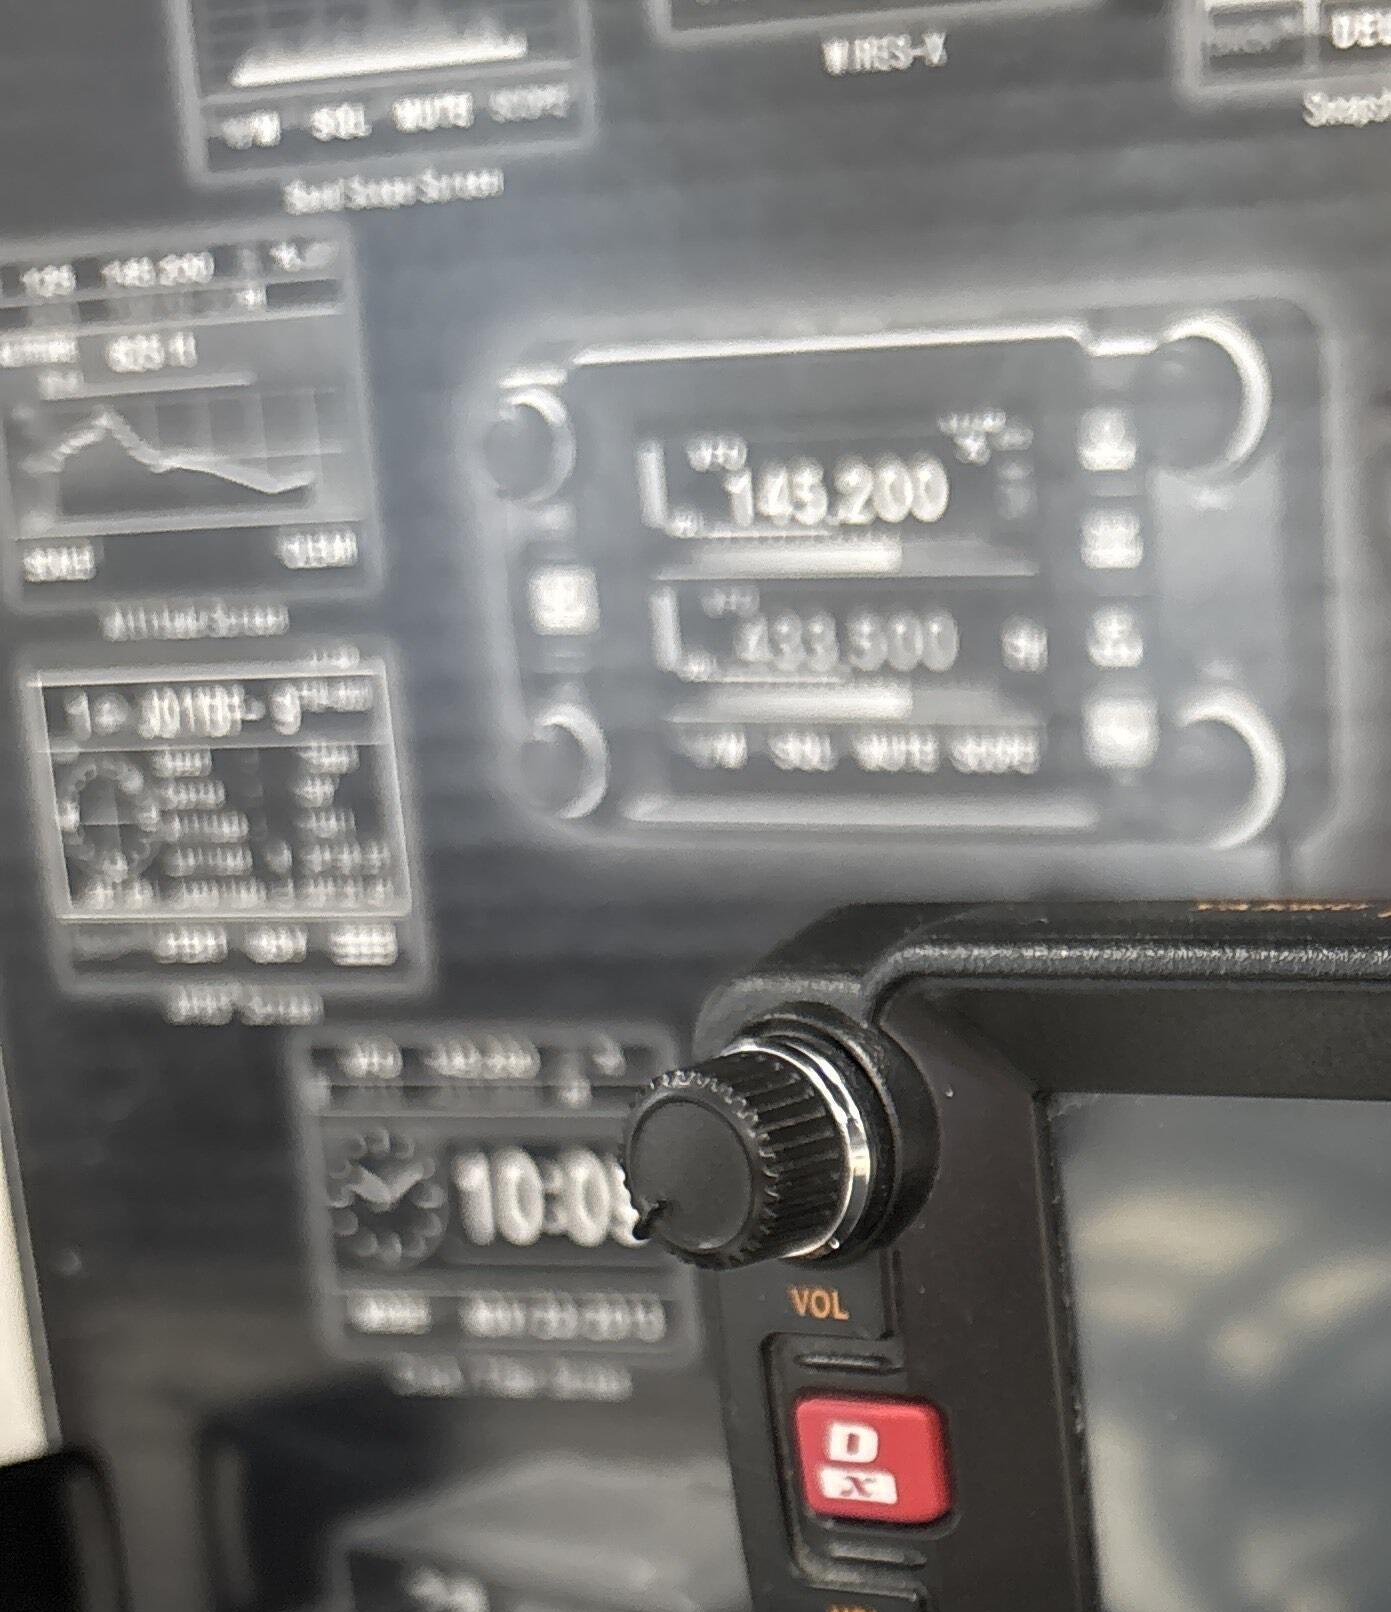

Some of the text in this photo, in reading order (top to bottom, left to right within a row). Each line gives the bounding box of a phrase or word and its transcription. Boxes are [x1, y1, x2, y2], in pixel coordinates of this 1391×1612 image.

[726, 450, 950, 526] 145.200
[788, 1285, 850, 1321] VOL
[826, 1422, 879, 1464] D
